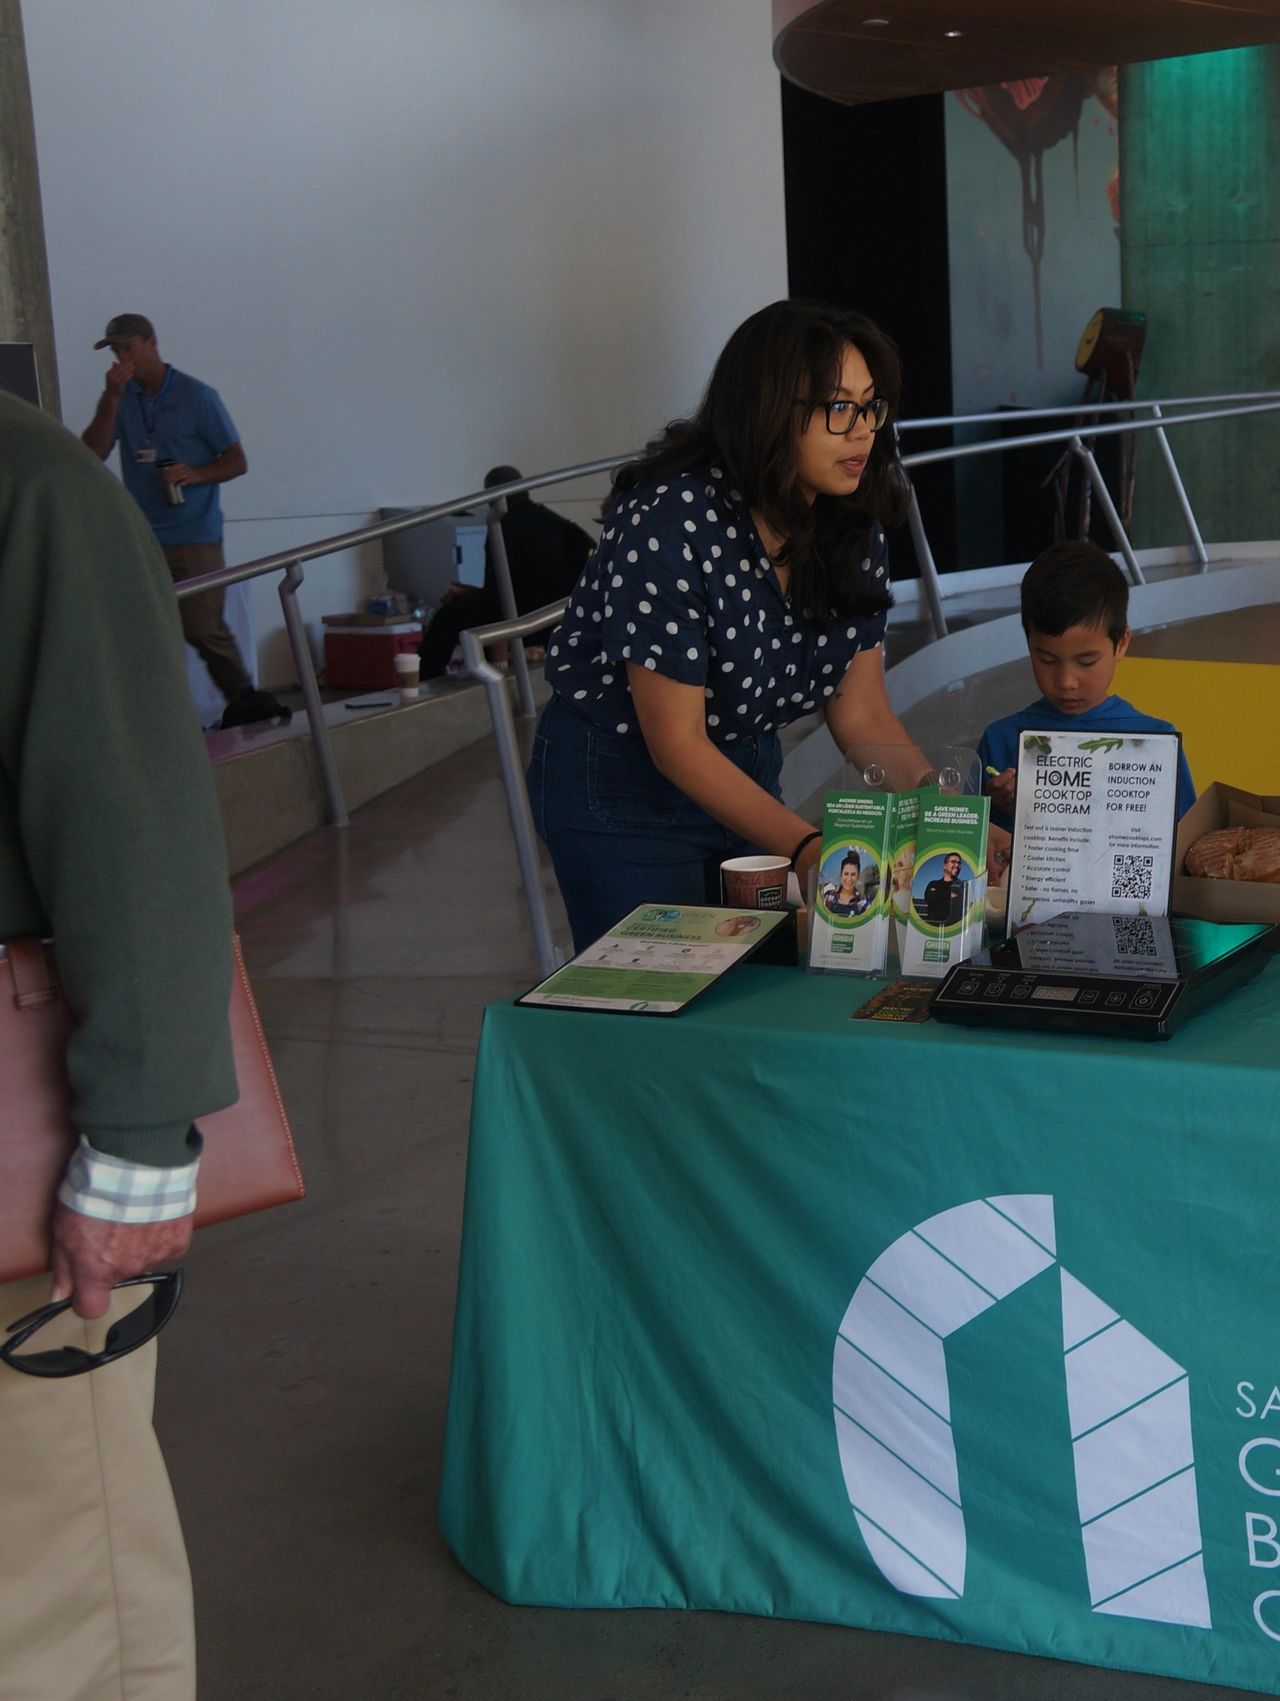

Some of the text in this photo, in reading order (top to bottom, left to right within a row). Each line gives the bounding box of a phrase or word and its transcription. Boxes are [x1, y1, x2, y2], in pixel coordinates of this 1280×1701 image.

[1036, 755, 1093, 768] ELECTRIC
[1108, 763, 1162, 772] BORROW AN
[1036, 770, 1092, 787] HOME
[1108, 776, 1156, 785] INDUCTION
[1034, 789, 1092, 801] COOKTOP
[1107, 790, 1150, 798] COOKTOP
[1033, 802, 1091, 815] PROGRAM
[1106, 802, 1146, 812] FOR FREE!
